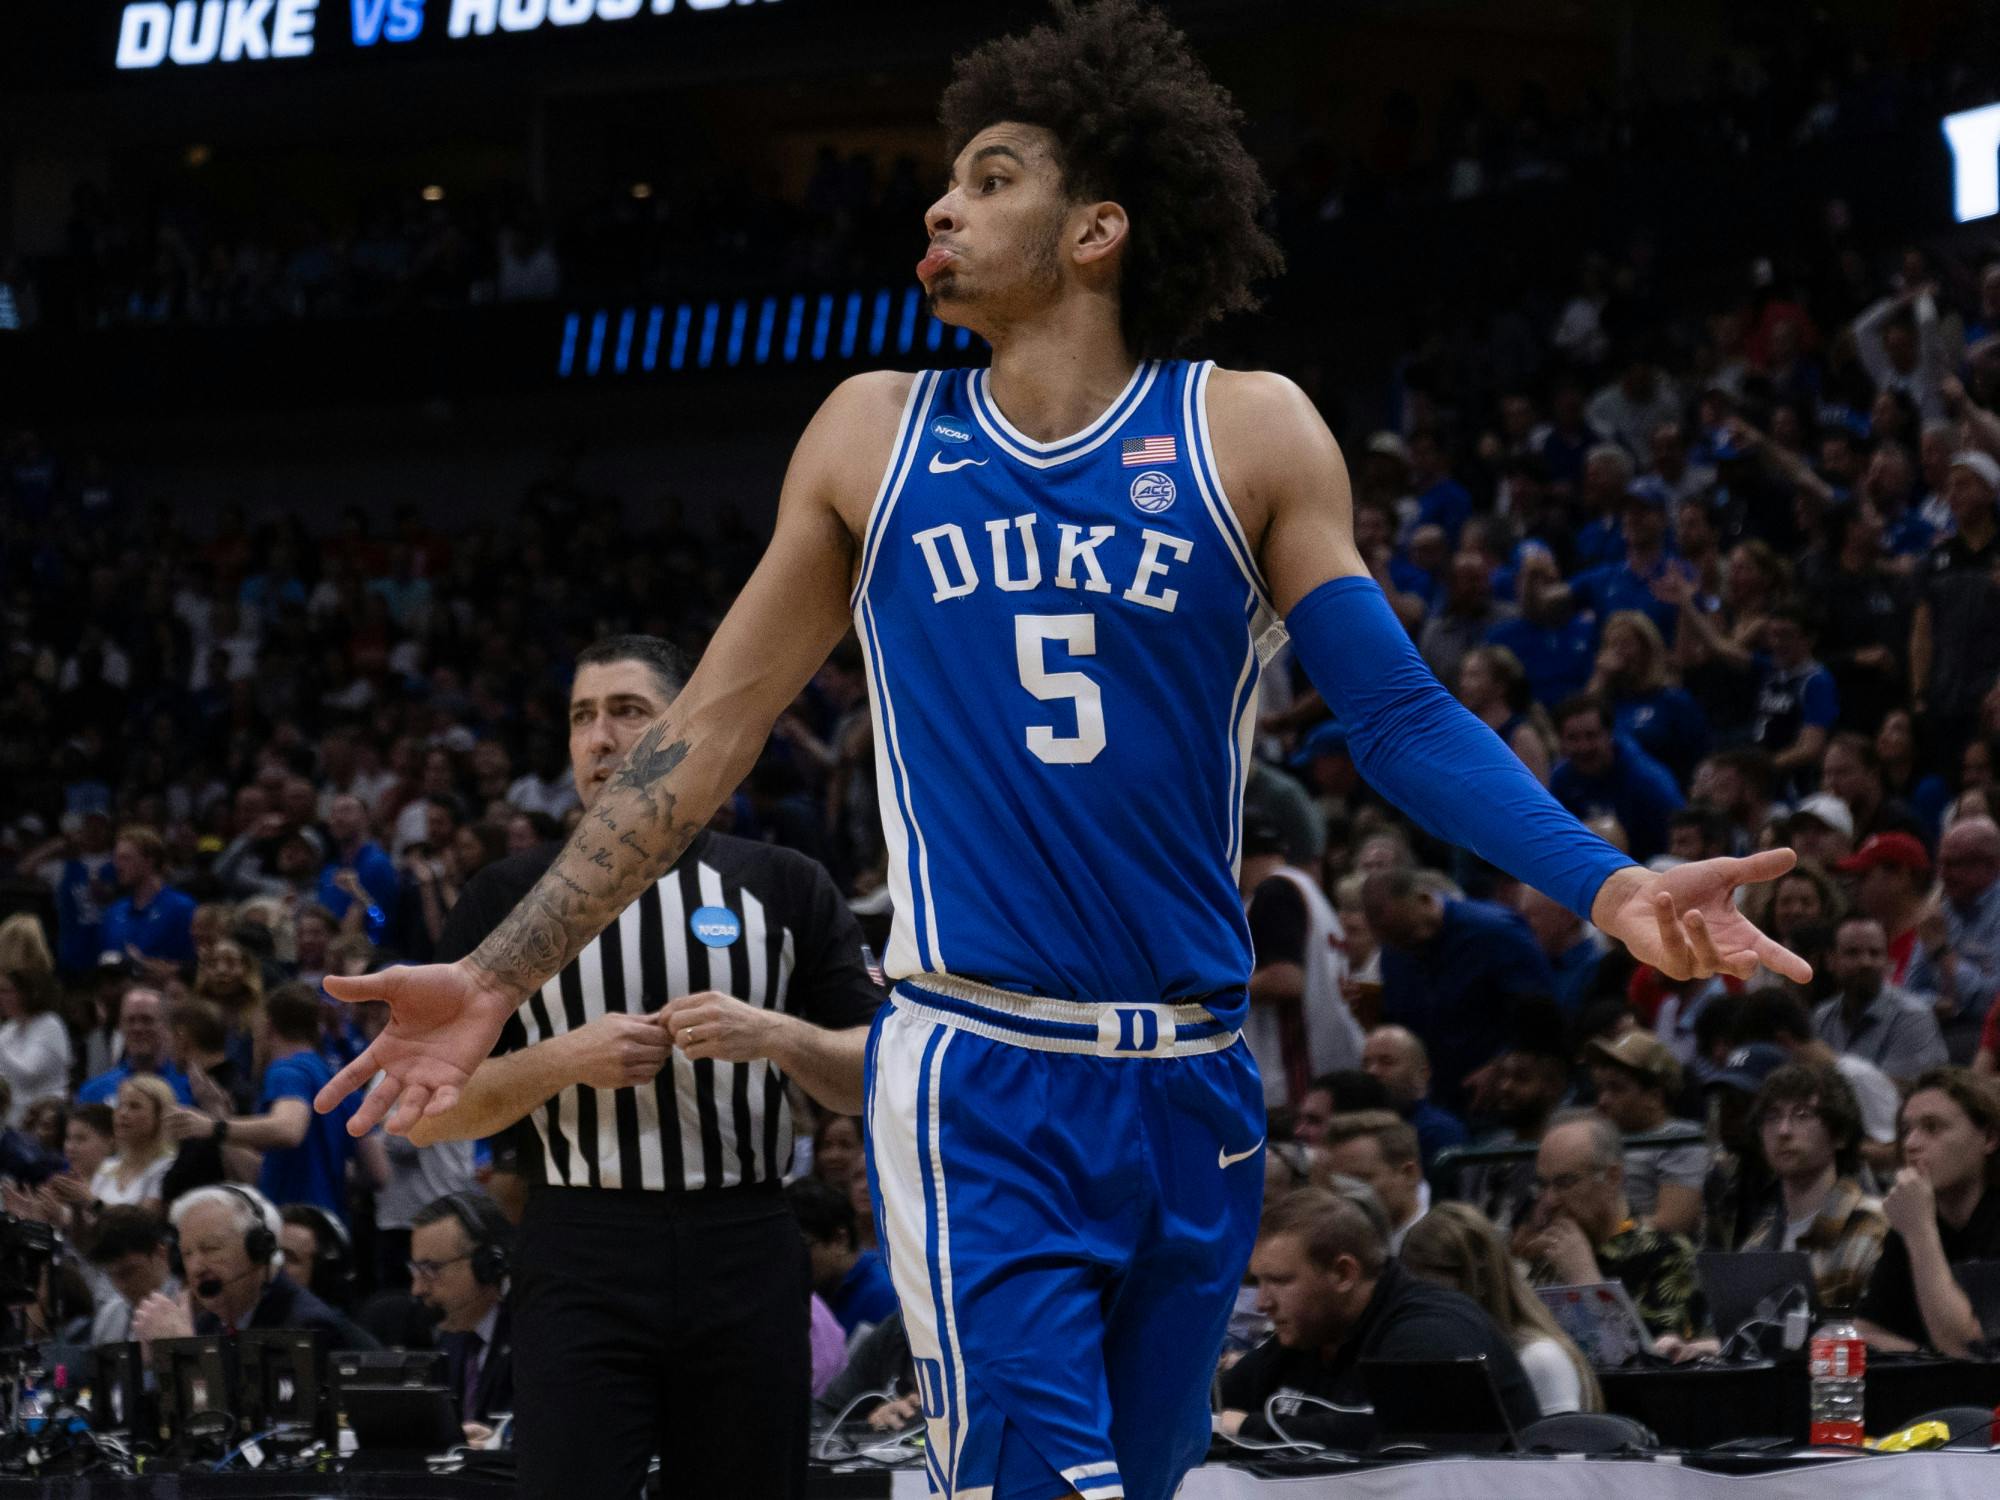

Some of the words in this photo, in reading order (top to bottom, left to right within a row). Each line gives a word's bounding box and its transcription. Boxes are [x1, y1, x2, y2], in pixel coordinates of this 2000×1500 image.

[116, 0, 319, 69] DUKE
[350, 0, 426, 46] VS
[934, 424, 970, 441] NCAA
[1138, 485, 1171, 495] ACC
[912, 513, 1194, 612] DUKE
[1015, 614, 1107, 764] 5
[1114, 1009, 1158, 1051] D
